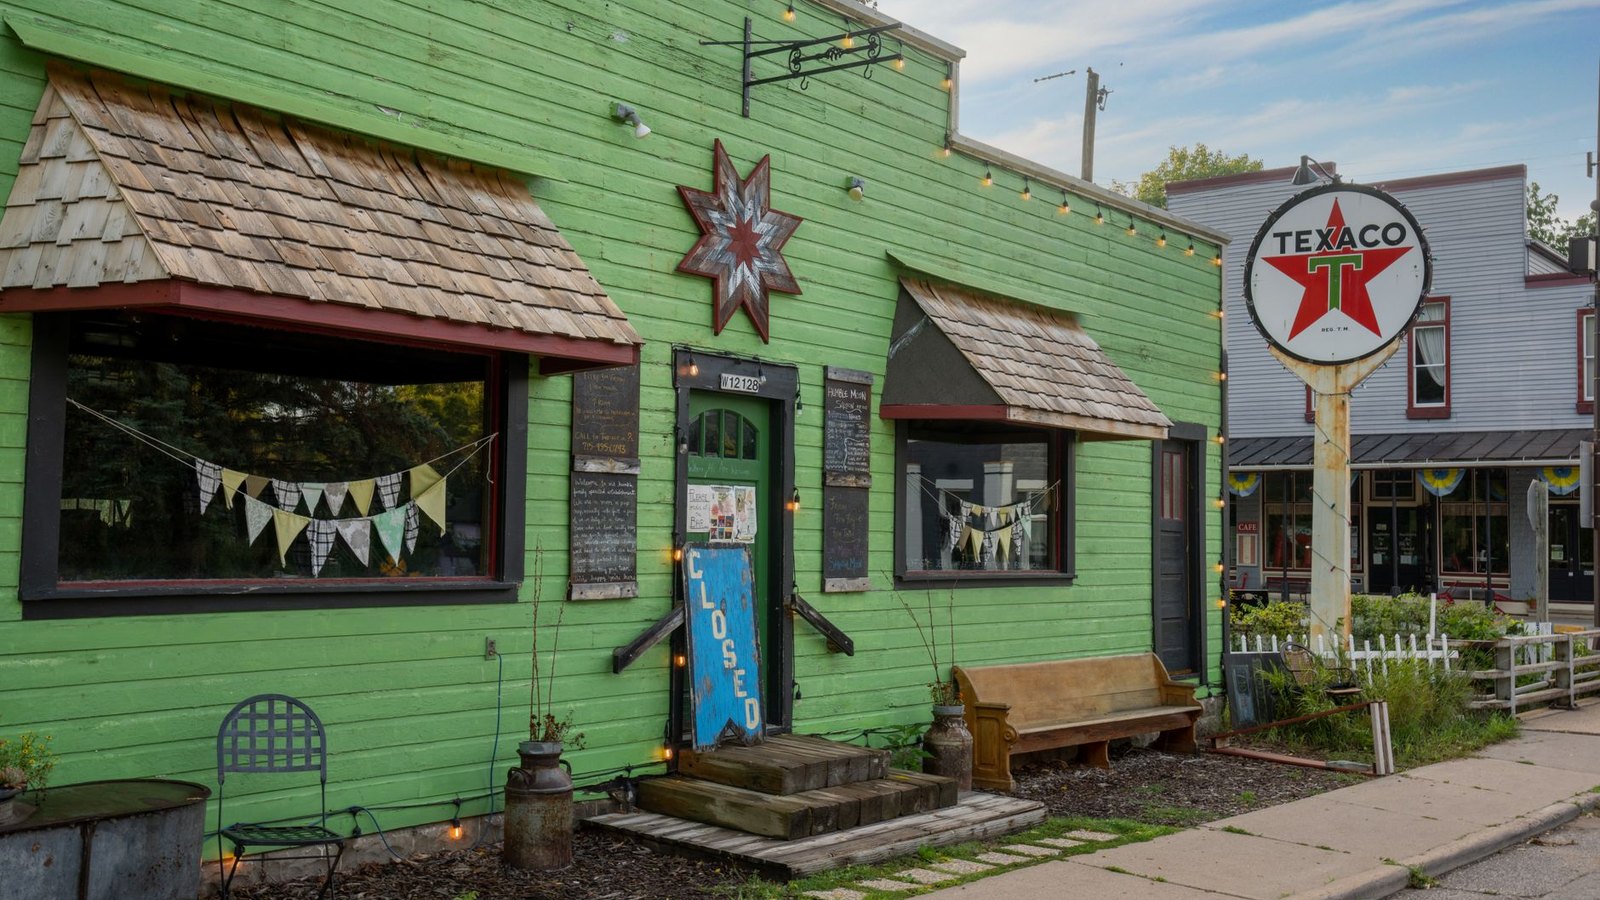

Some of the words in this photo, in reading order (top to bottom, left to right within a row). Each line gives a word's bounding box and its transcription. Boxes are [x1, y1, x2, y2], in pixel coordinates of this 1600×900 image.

[1273, 222, 1407, 254] TEXACO
[1308, 253, 1363, 311] T
[827, 386, 849, 399] HUMBLE
[850, 389, 867, 401] MOON
[1238, 523, 1257, 531] CAFE
[687, 549, 760, 730] CLOSED
